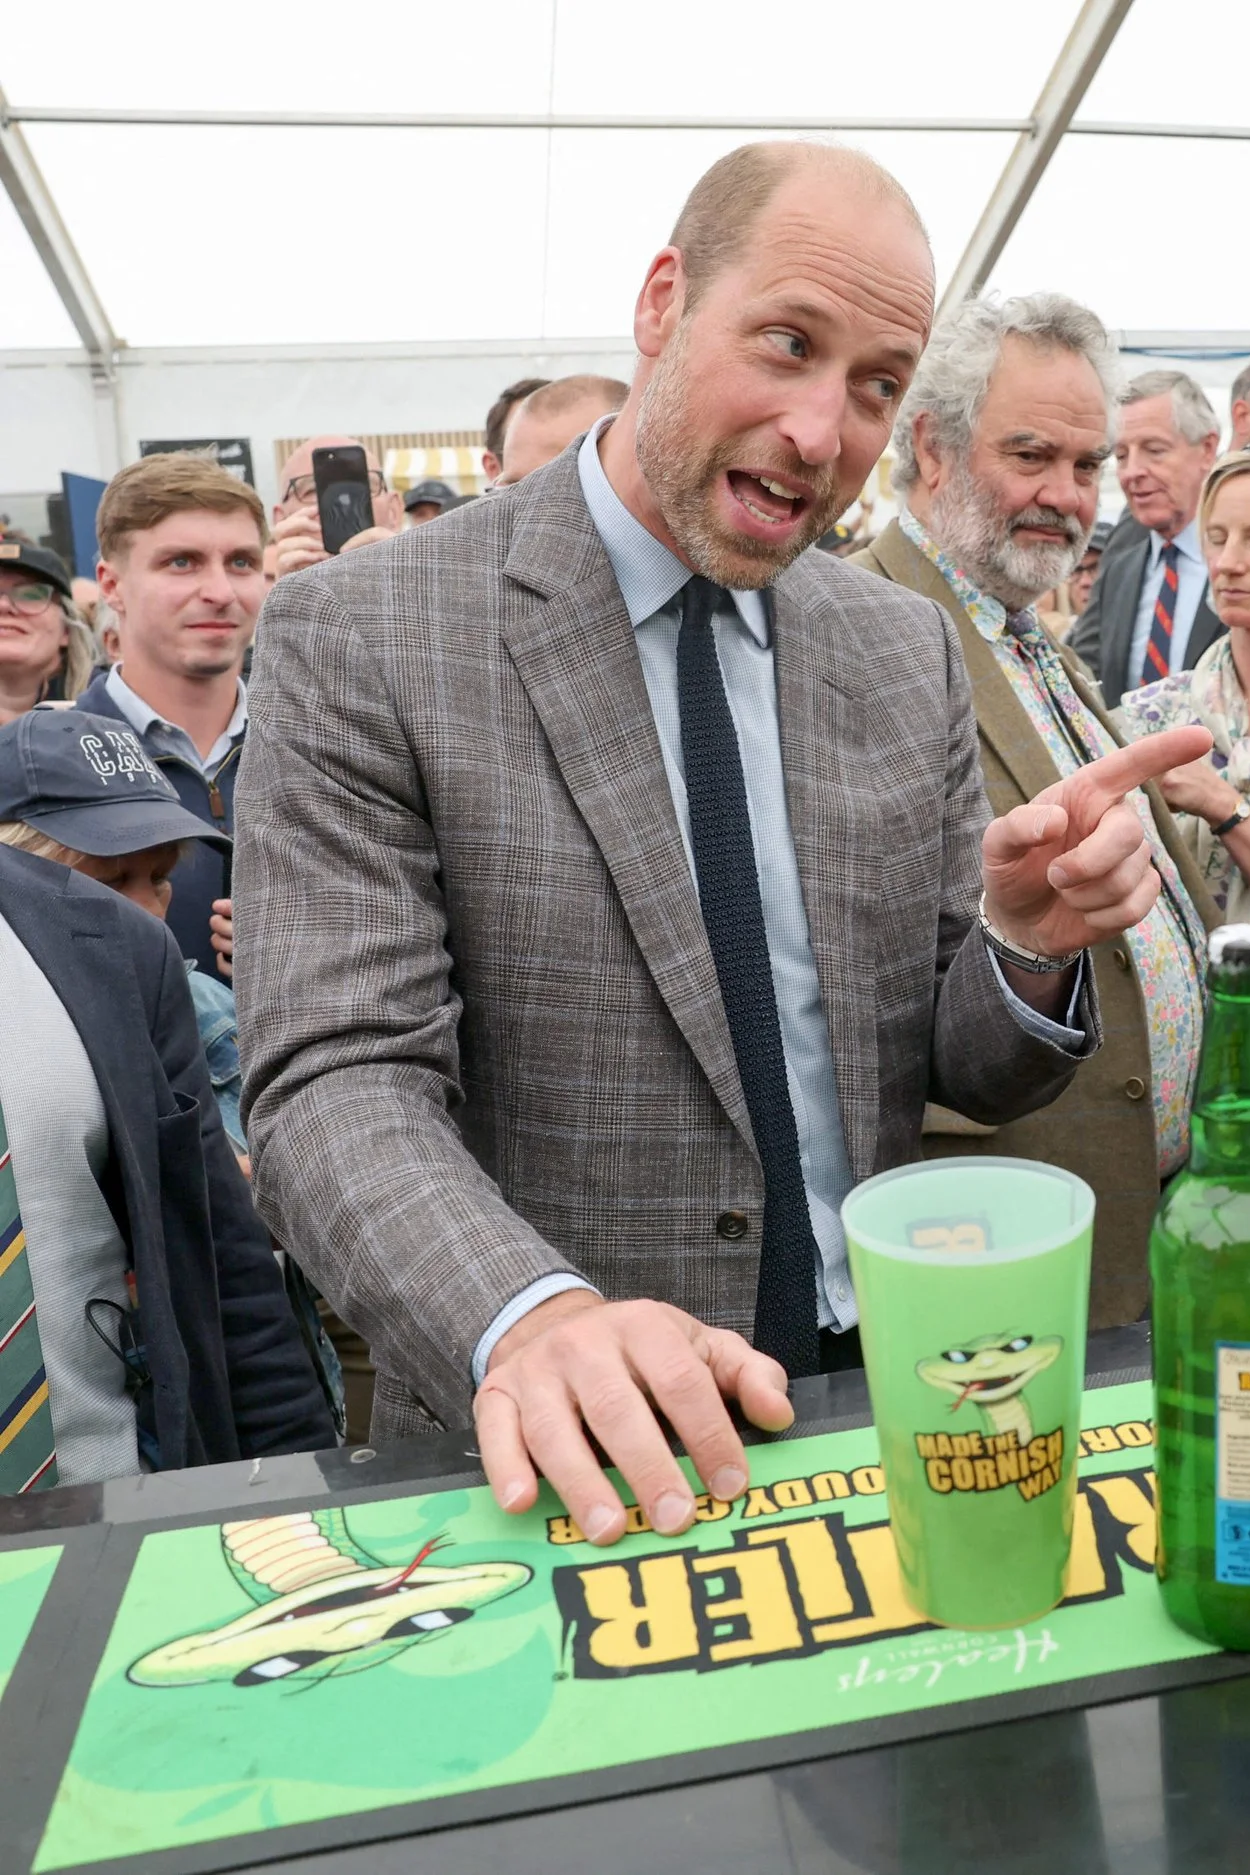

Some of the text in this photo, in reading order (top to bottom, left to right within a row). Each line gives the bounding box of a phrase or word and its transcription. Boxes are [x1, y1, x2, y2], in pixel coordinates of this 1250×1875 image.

[915, 1429, 1020, 1459] MADE THE
[925, 1425, 1063, 1494] CORNISH
[1016, 1459, 1062, 1502] WAY
[837, 1629, 1059, 1692] Healeys
